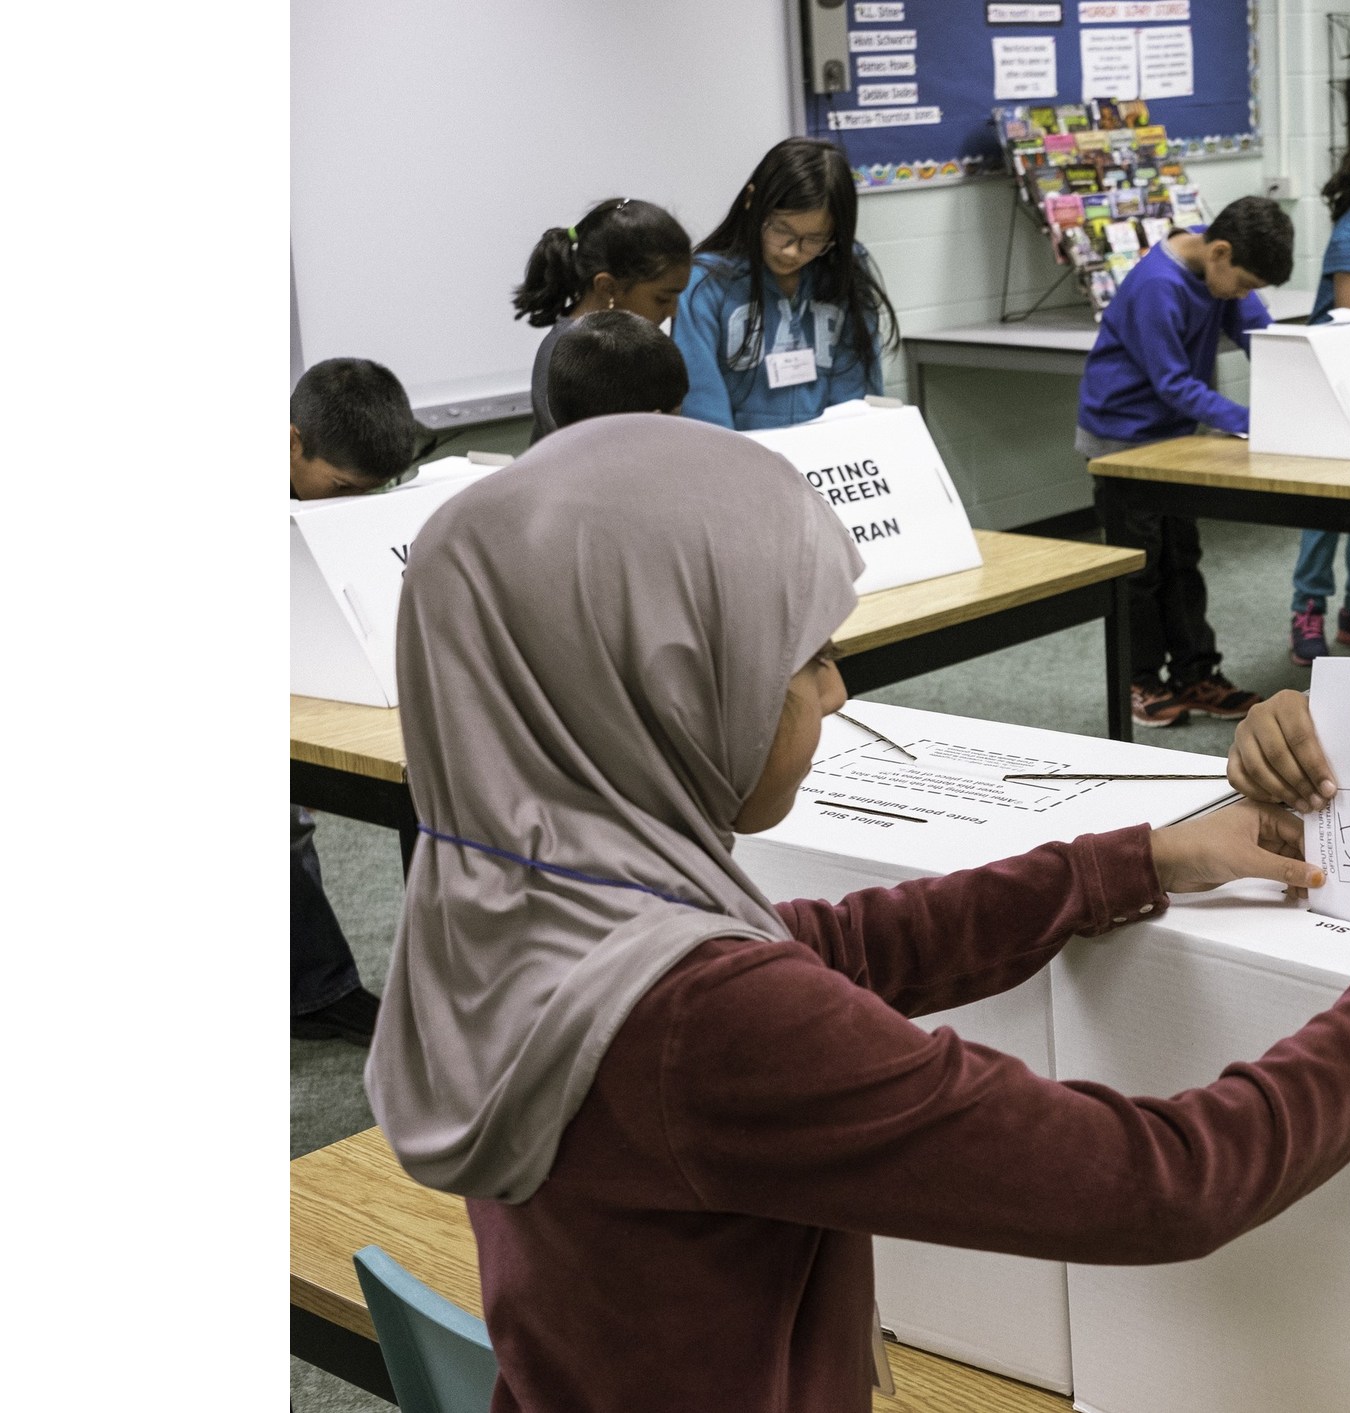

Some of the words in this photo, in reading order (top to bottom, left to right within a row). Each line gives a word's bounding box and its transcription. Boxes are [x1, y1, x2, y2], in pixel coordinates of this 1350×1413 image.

[806, 459, 879, 488] OTING
[818, 478, 891, 506] REEN
[847, 518, 901, 543] RAN
[945, 787, 989, 798] inserting
[848, 795, 908, 810] bulletins
[820, 810, 850, 820] Slot
[909, 806, 946, 816] pour
[851, 816, 895, 828] Ballot
[946, 813, 988, 825] Fente
[1315, 921, 1350, 933] Slot
